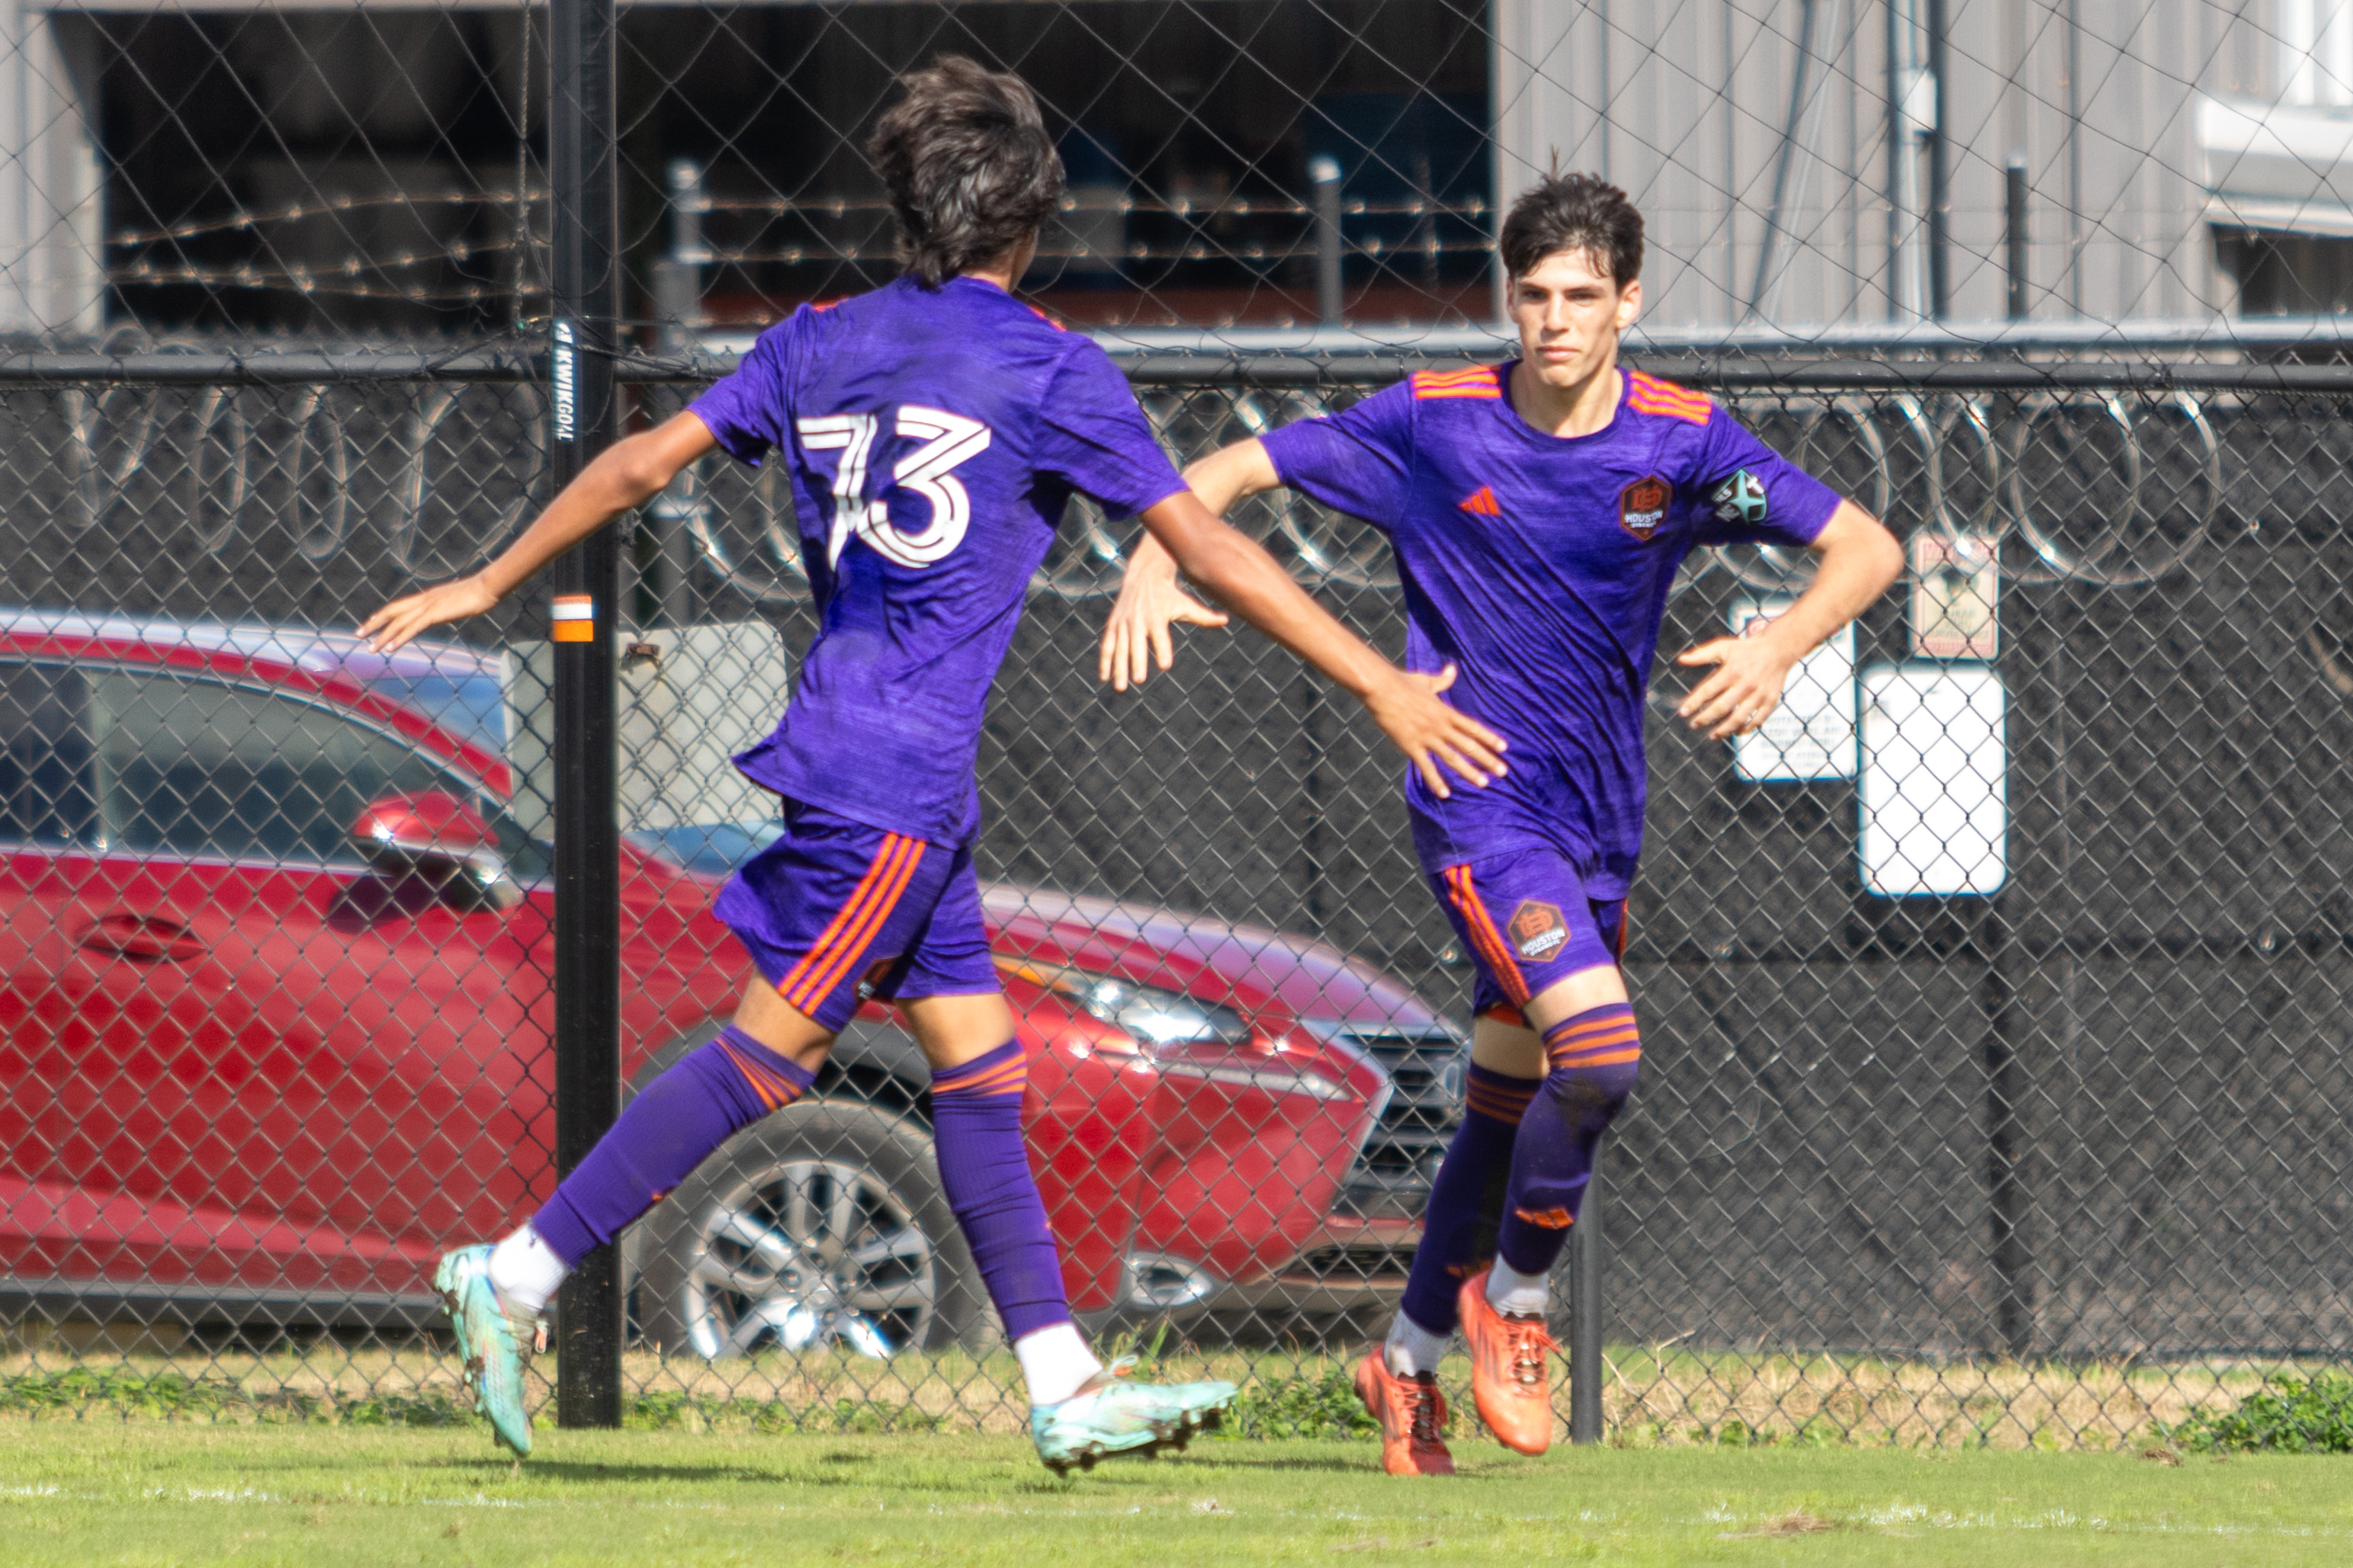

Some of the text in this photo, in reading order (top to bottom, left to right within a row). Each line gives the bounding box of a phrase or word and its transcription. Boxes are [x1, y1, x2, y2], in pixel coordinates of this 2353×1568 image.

[557, 348, 573, 441] KWIKGOAL
[797, 405, 990, 572] 73
[1521, 928, 1565, 955] HOUSTON
